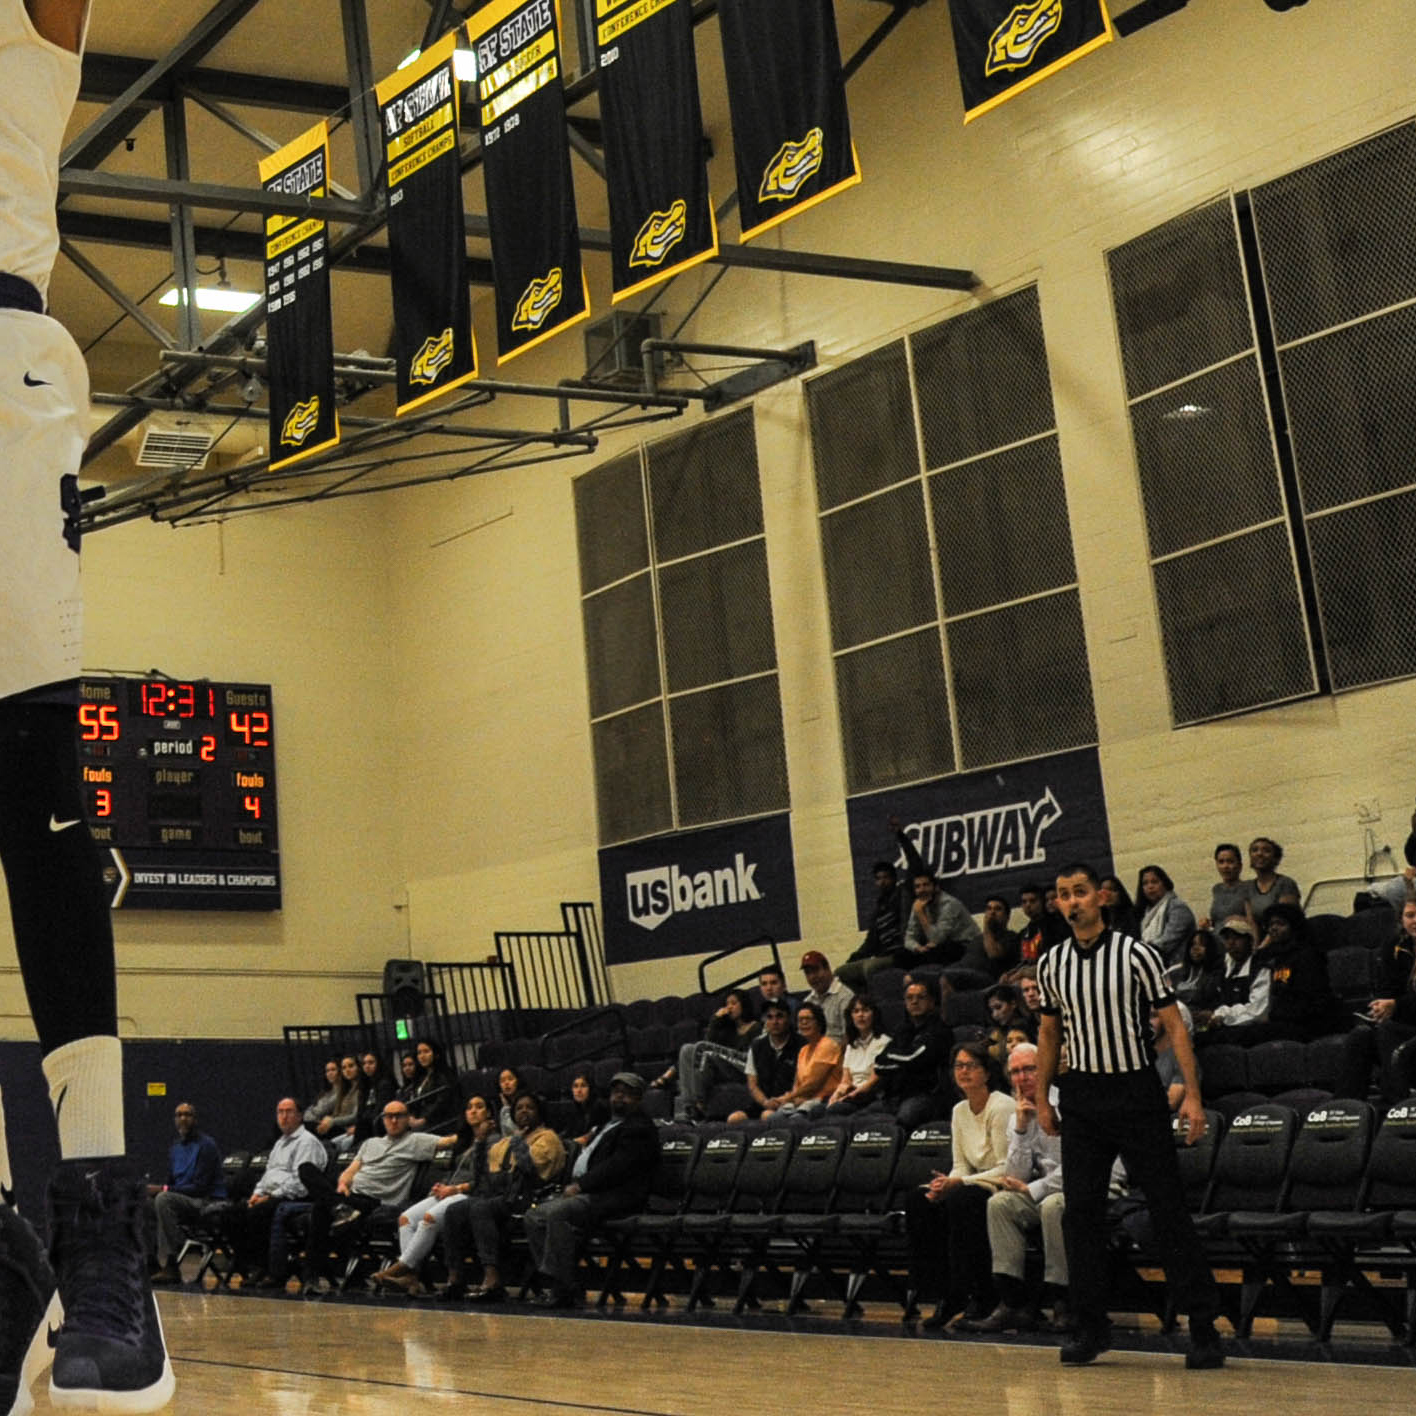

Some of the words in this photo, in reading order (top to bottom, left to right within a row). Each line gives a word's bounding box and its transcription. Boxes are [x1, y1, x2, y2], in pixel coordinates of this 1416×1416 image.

[602, 2, 648, 40] CONFERENCE
[478, 33, 498, 73] SF
[403, 119, 435, 149] SOFTBALL
[390, 151, 427, 183] CONFERENCE
[427, 134, 453, 159] CHAMPS
[284, 153, 323, 196] STATE
[225, 689, 266, 706] Guests
[79, 704, 119, 740] 55
[153, 739, 193, 756] period
[200, 736, 216, 762] 2
[83, 766, 112, 783] fouls
[155, 768, 194, 784] player
[236, 772, 264, 788] fouls
[95, 789, 112, 817] 3
[244, 795, 261, 820] 4
[161, 828, 192, 843] game
[178, 873, 217, 885] LEADERS
[227, 874, 276, 886] CHAMPIONS
[1233, 1115, 1252, 1126] CoB
[1307, 1110, 1328, 1122] CoB
[1387, 1107, 1408, 1119] CoB
